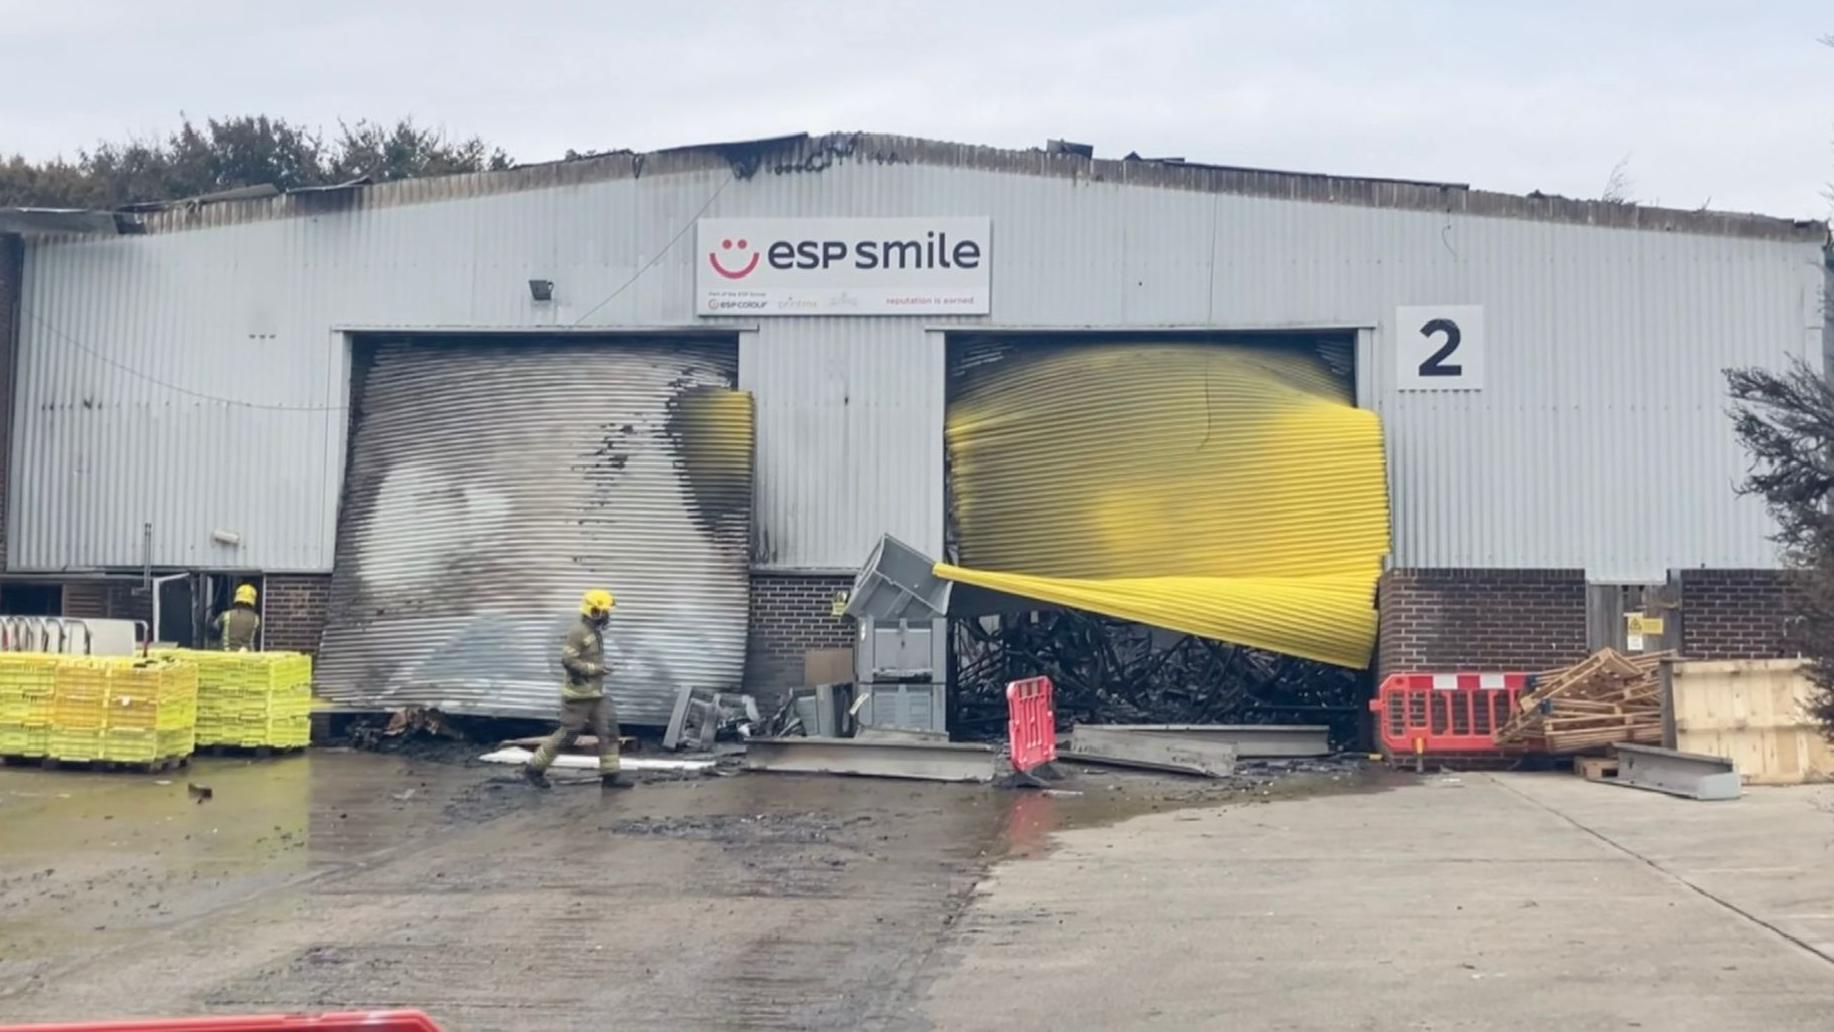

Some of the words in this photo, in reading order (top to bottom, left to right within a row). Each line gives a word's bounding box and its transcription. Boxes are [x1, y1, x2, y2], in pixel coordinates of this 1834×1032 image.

[855, 231, 981, 269] smile
[885, 296, 932, 305] reputation
[933, 296, 942, 304] is
[943, 296, 975, 304] earned
[1418, 318, 1462, 376] 2
